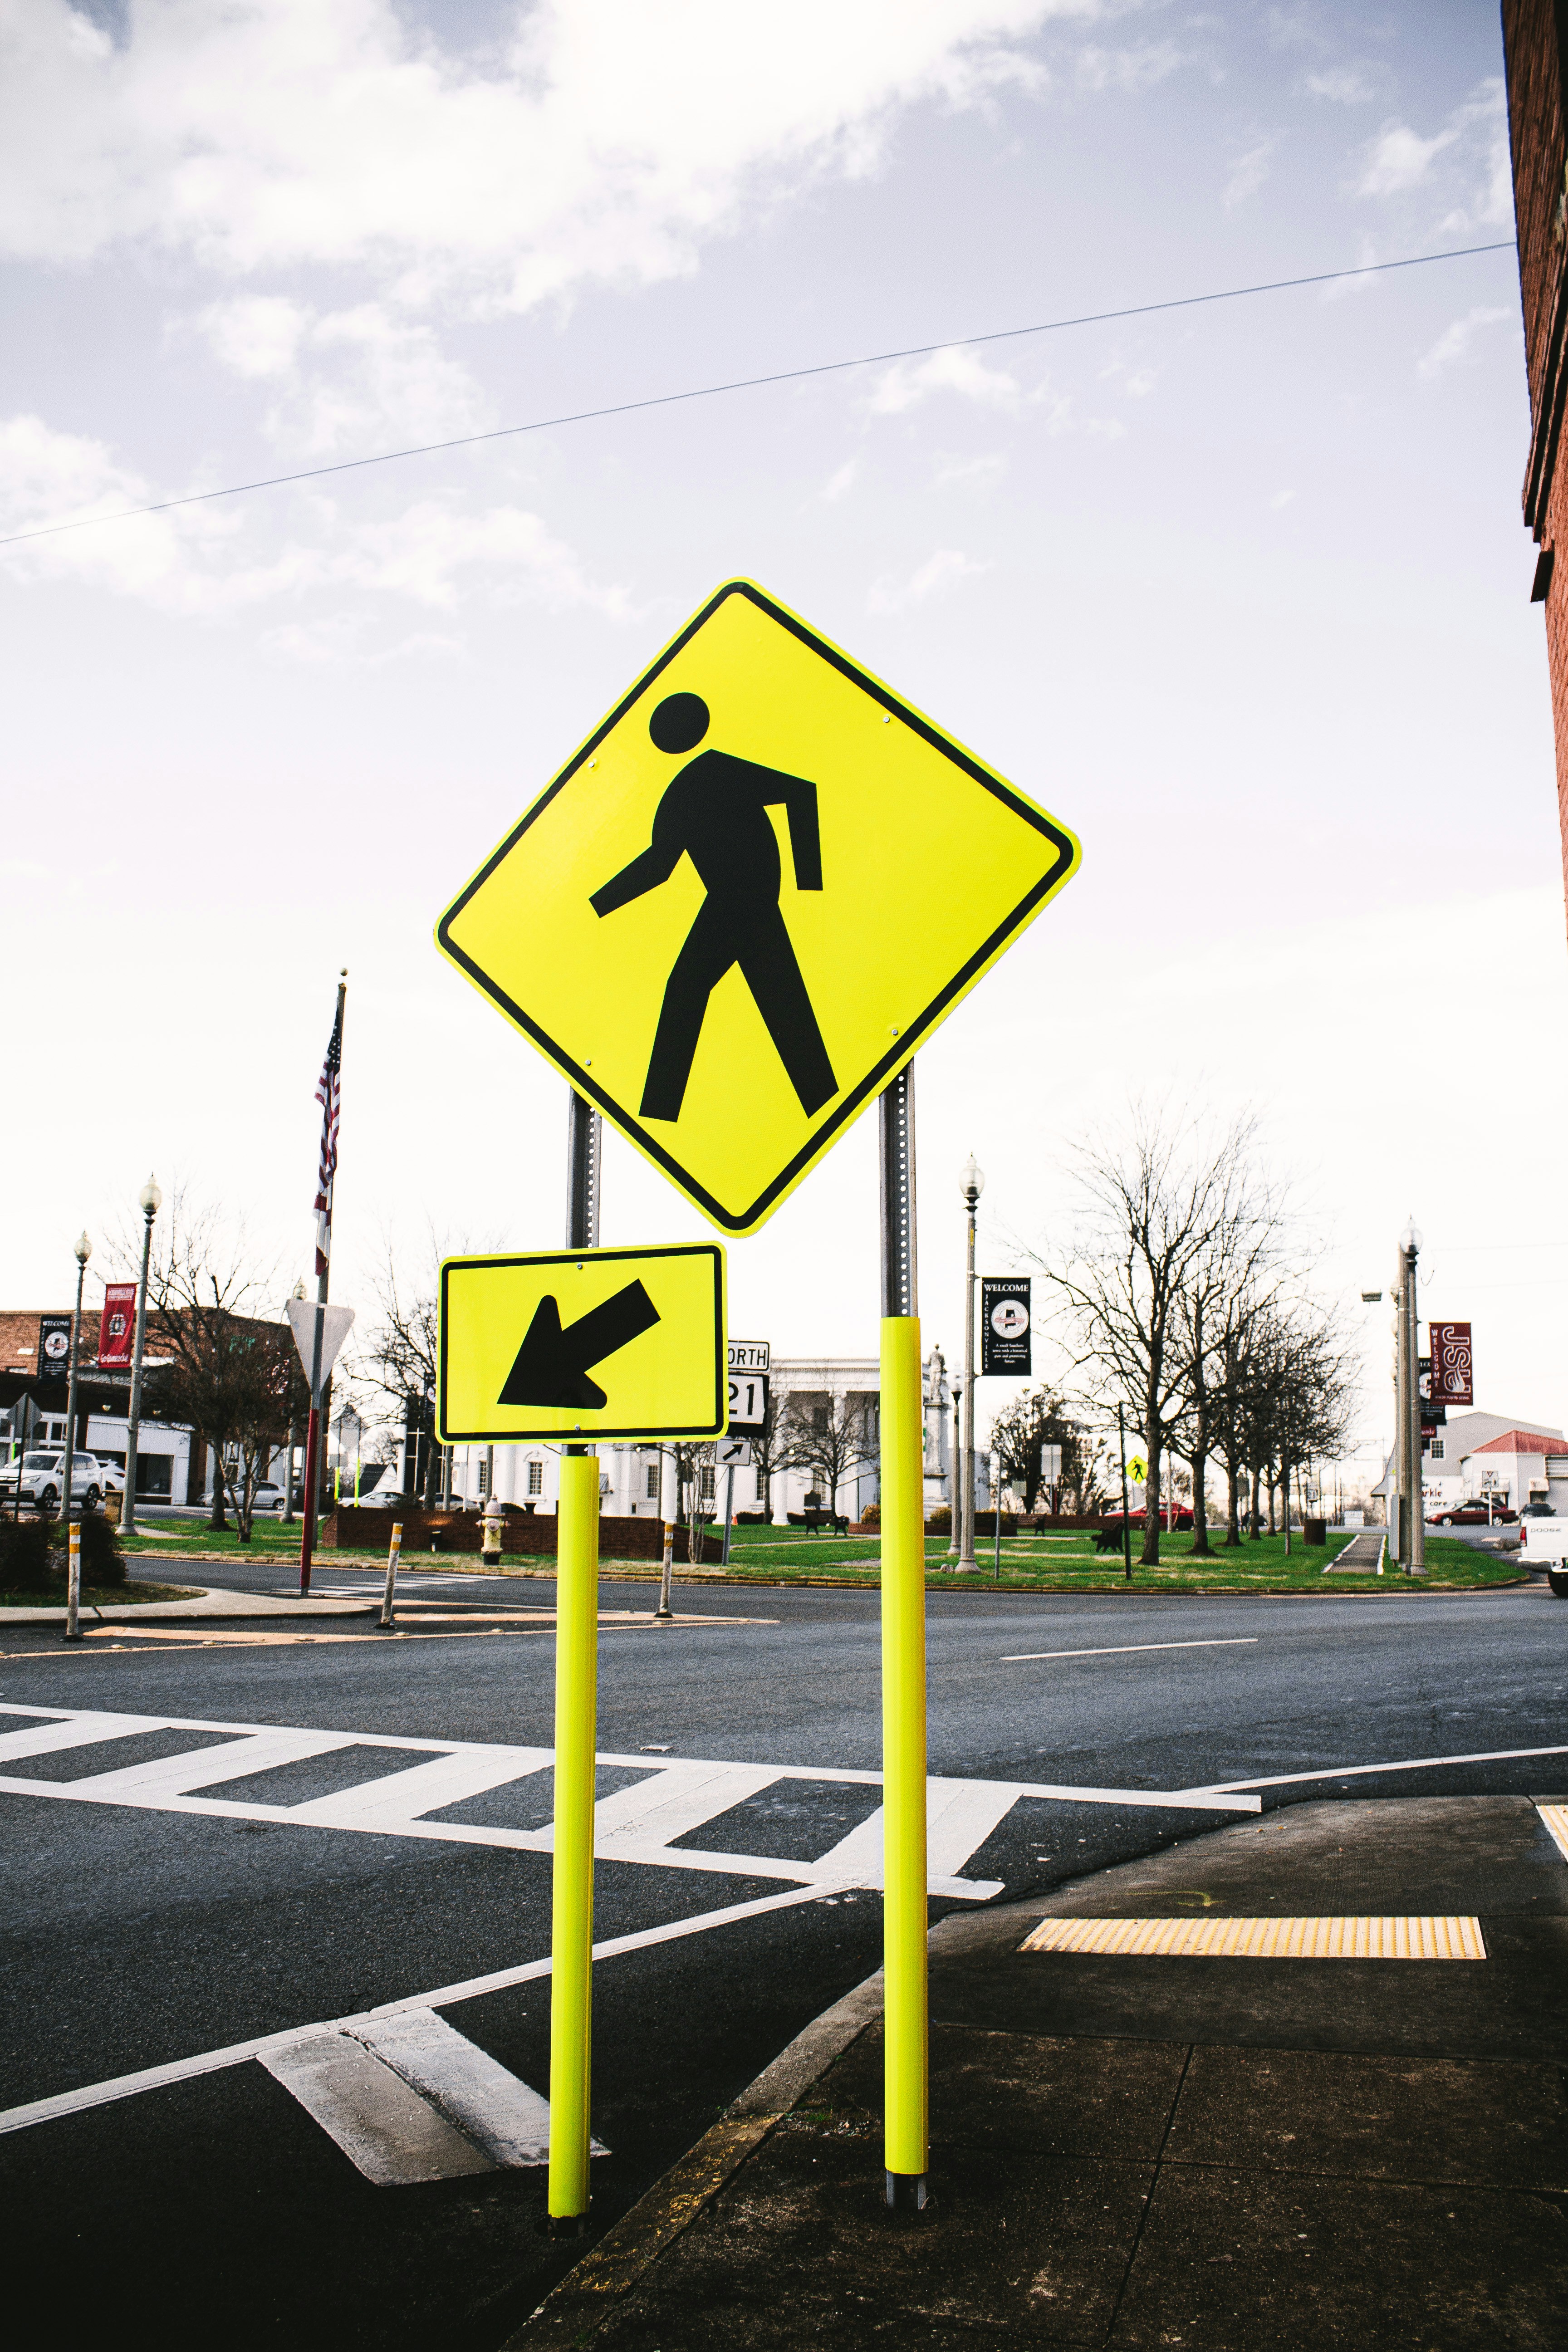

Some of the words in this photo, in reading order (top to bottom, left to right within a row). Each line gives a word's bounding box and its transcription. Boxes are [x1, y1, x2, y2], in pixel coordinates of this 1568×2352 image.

[984, 1284, 1029, 1292] WELCOME
[728, 1348, 766, 1365] ORTH
[1431, 1329, 1440, 1387] WELCOME
